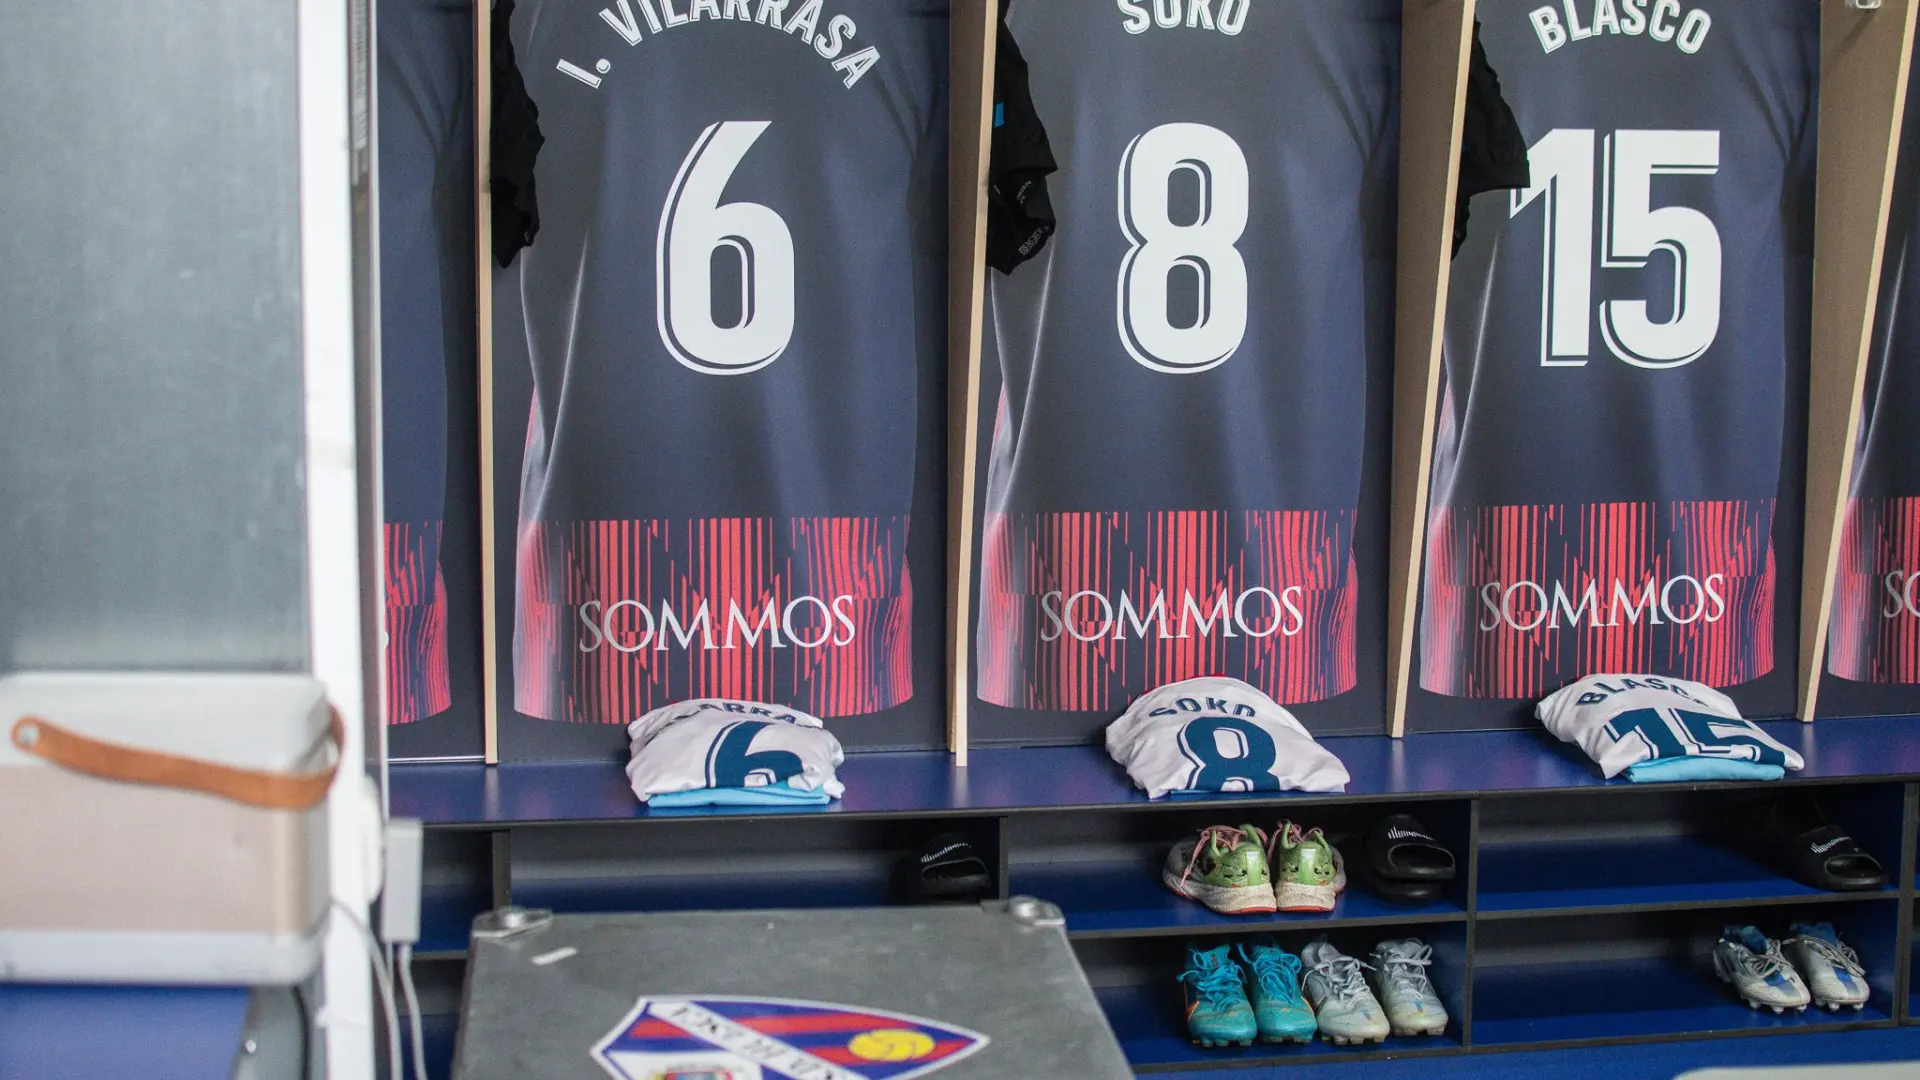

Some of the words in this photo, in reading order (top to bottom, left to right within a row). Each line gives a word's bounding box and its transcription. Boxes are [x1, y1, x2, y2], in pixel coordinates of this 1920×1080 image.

[1528, 0, 1712, 54] BLASCO
[556, 58, 611, 89] I.
[656, 120, 795, 376] 6
[1117, 122, 1249, 375] 8
[1510, 128, 1722, 369] 15
[579, 594, 856, 654] SOMMOS
[1040, 585, 1304, 642] SOMMOS
[1479, 573, 1726, 632] SOMMOS
[704, 720, 804, 789] 6
[1176, 716, 1281, 792] 8
